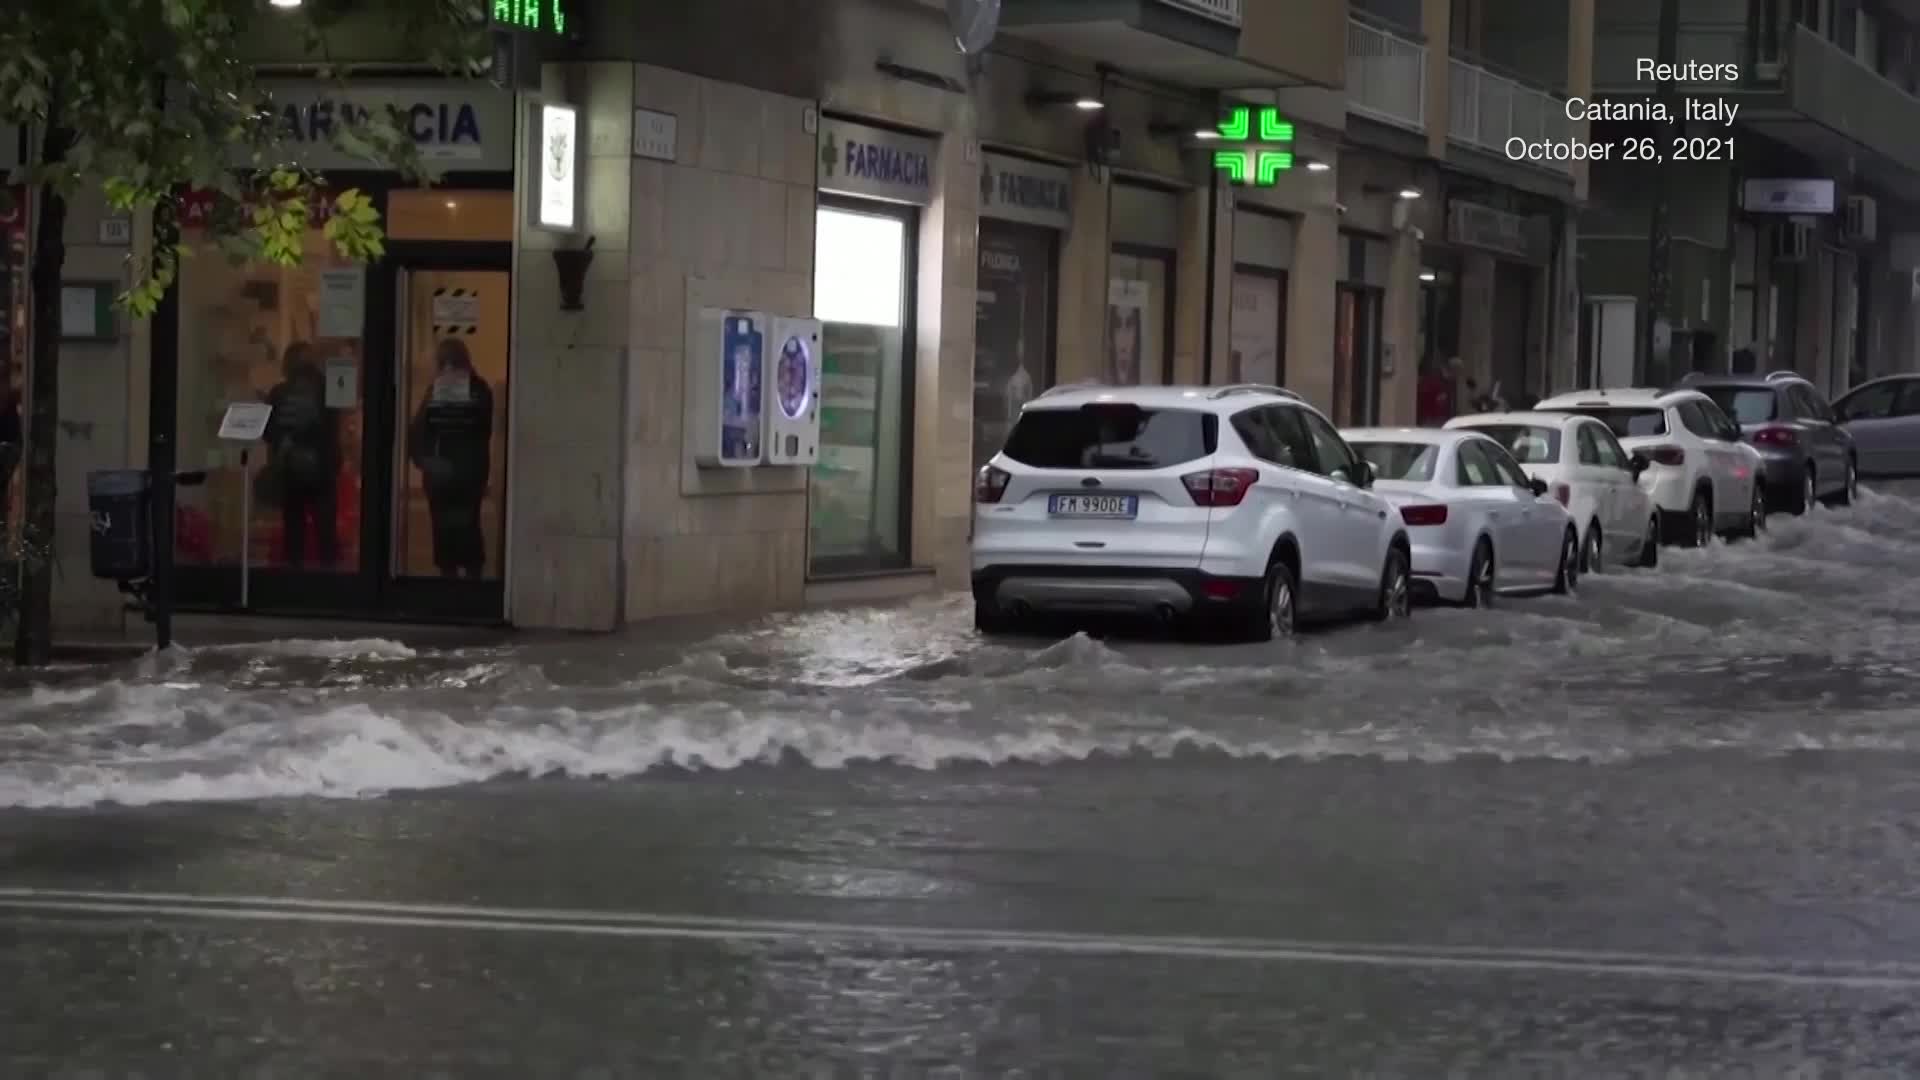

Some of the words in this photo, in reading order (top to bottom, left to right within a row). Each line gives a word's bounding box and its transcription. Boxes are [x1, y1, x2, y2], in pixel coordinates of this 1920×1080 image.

[253, 102, 482, 144] ARMCIA
[845, 139, 929, 187] FARMACIA
[1059, 495, 1077, 512] FM
